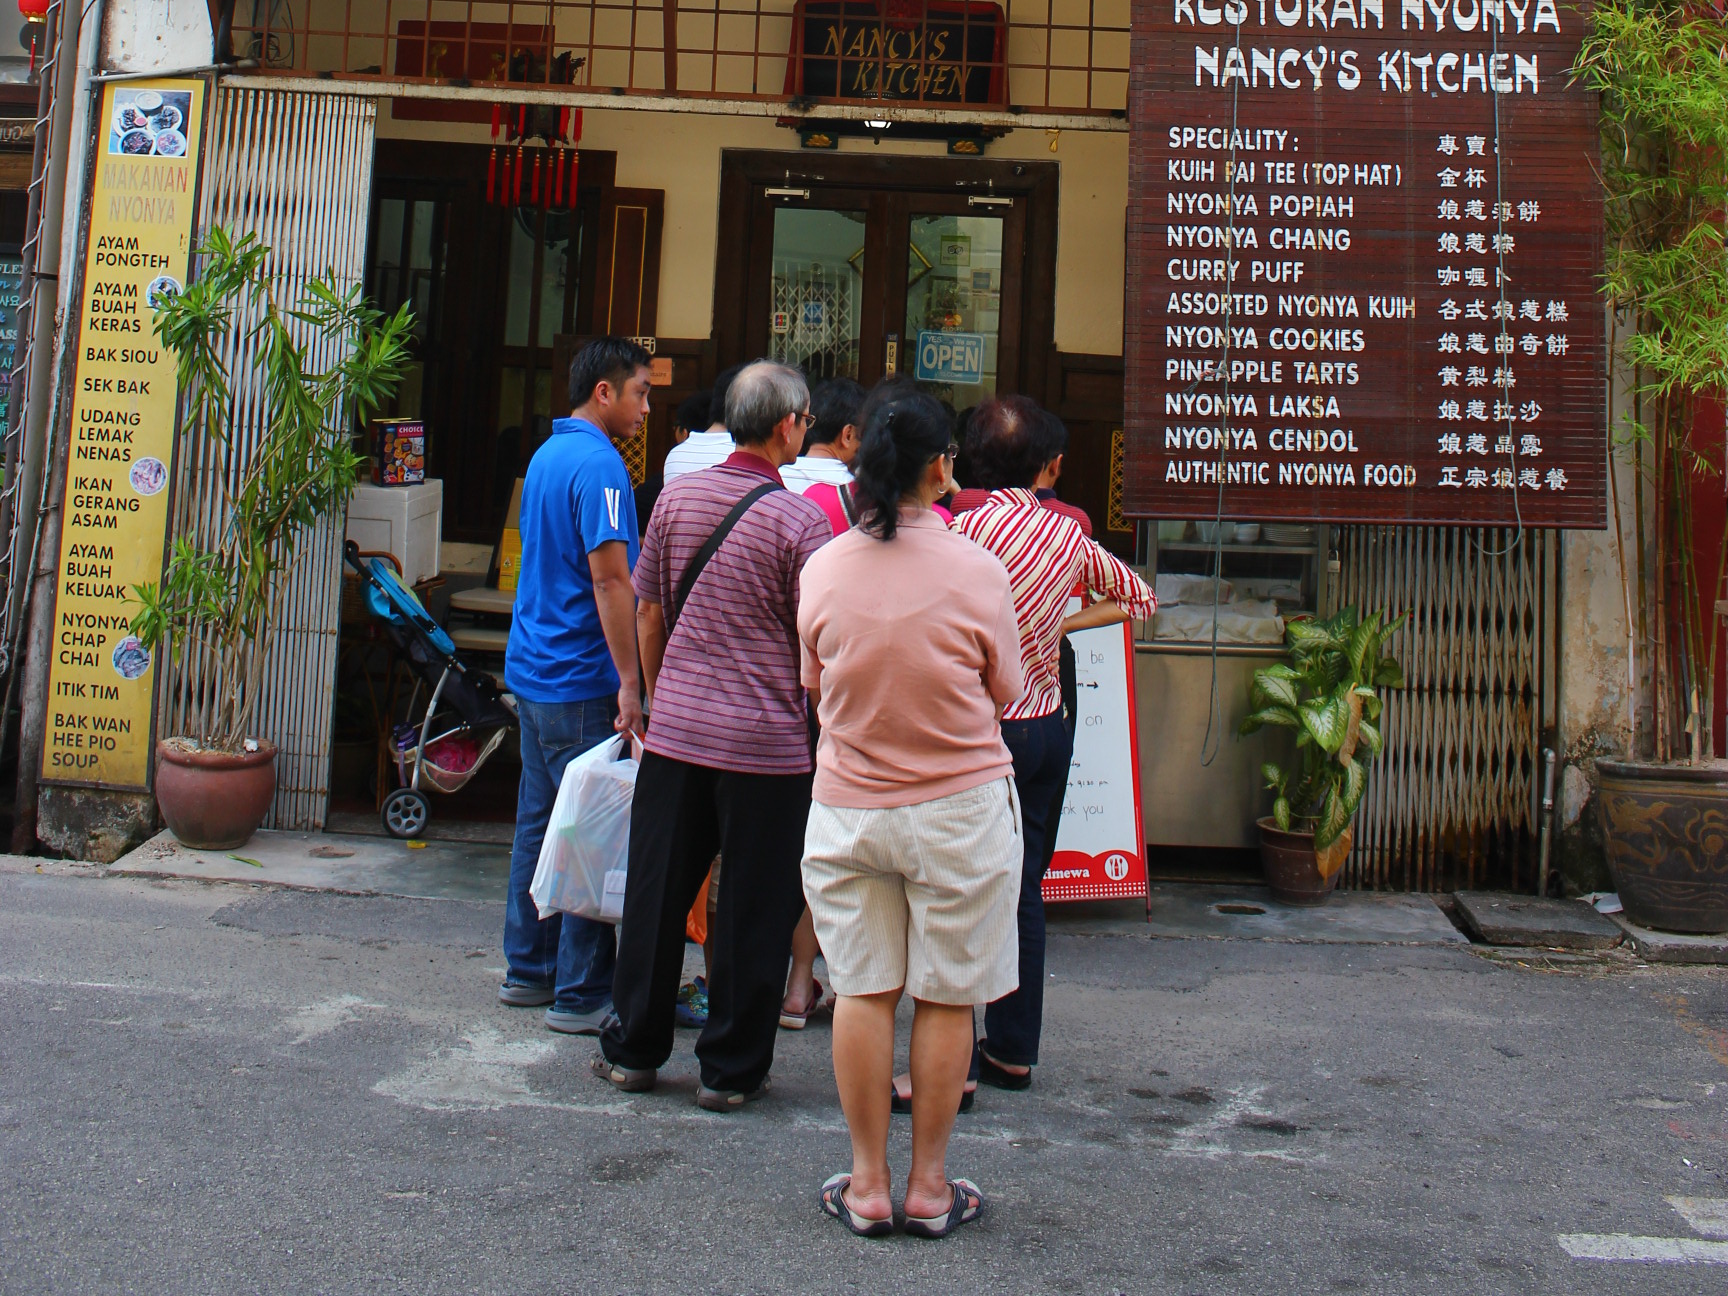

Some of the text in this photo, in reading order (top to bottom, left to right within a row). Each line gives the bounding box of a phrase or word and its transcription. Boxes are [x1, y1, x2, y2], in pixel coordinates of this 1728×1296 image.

[824, 25, 950, 61] NANCY'S
[853, 60, 972, 96] KITCHEN
[1194, 45, 1539, 95] NANCY'S KITCHEN
[103, 163, 188, 193] MAKANAN
[1016, 166, 1022, 175] 7
[1167, 161, 1215, 182] KUIH
[1225, 162, 1255, 184] PAI
[1264, 162, 1296, 185] TEE
[1436, 166, 1488, 188] 金杯
[109, 195, 176, 225] NYONYA
[1167, 193, 1354, 219] NYONYA POPIAH
[97, 236, 139, 251] AYAM
[1167, 226, 1351, 252] NYONYA CHANG
[96, 252, 169, 268] PONGTEH
[1167, 258, 1304, 283] CURRY PUFF
[93, 282, 138, 297] AYAM
[91, 299, 137, 314] BUAH
[1167, 293, 1416, 319] ASSORTED NYONYA KUIH
[1437, 298, 1569, 322] 各式娘惹糕
[90, 318, 141, 332] KERAS
[1166, 326, 1365, 352] NYONYA COOKIES
[1437, 332, 1570, 356] 娘惹曲奇餅
[86, 348, 158, 364] BAK SIOU
[923, 344, 979, 372] OPEN
[1165, 359, 1360, 385] PINEAPPLE TARTS
[84, 378, 150, 395] SEK BAK
[1165, 393, 1341, 419] NYONYA LAKSA
[1438, 399, 1543, 422] 娘惹拉沙
[81, 409, 141, 426] UDANG
[79, 427, 134, 444] LEMAK
[1165, 427, 1359, 453] NYONYA CENDOL
[1437, 432, 1543, 457] 娘惹晶露
[77, 446, 131, 462] NENAS
[1165, 461, 1417, 487] AUTHENTIC NYONYA FOOD
[1437, 466, 1569, 491] 正宗娘惹餐
[74, 476, 112, 491] IKAN
[73, 495, 140, 512] GERANG
[71, 514, 118, 529] ASAM
[69, 544, 113, 559] AYAM
[67, 562, 112, 579] BUAH
[65, 582, 127, 599] KELUAK
[62, 612, 129, 631] NYONYA
[61, 632, 106, 648] CHAP
[60, 650, 99, 667] CHAI
[1090, 650, 1104, 664] be
[57, 682, 119, 700] ITIK TIM
[55, 713, 131, 733] BAK WAN
[1085, 714, 1103, 726] on
[53, 732, 116, 750] HEE PIO
[52, 752, 99, 768] SOUP
[1083, 805, 1104, 821] you
[1042, 867, 1090, 880] timewa
